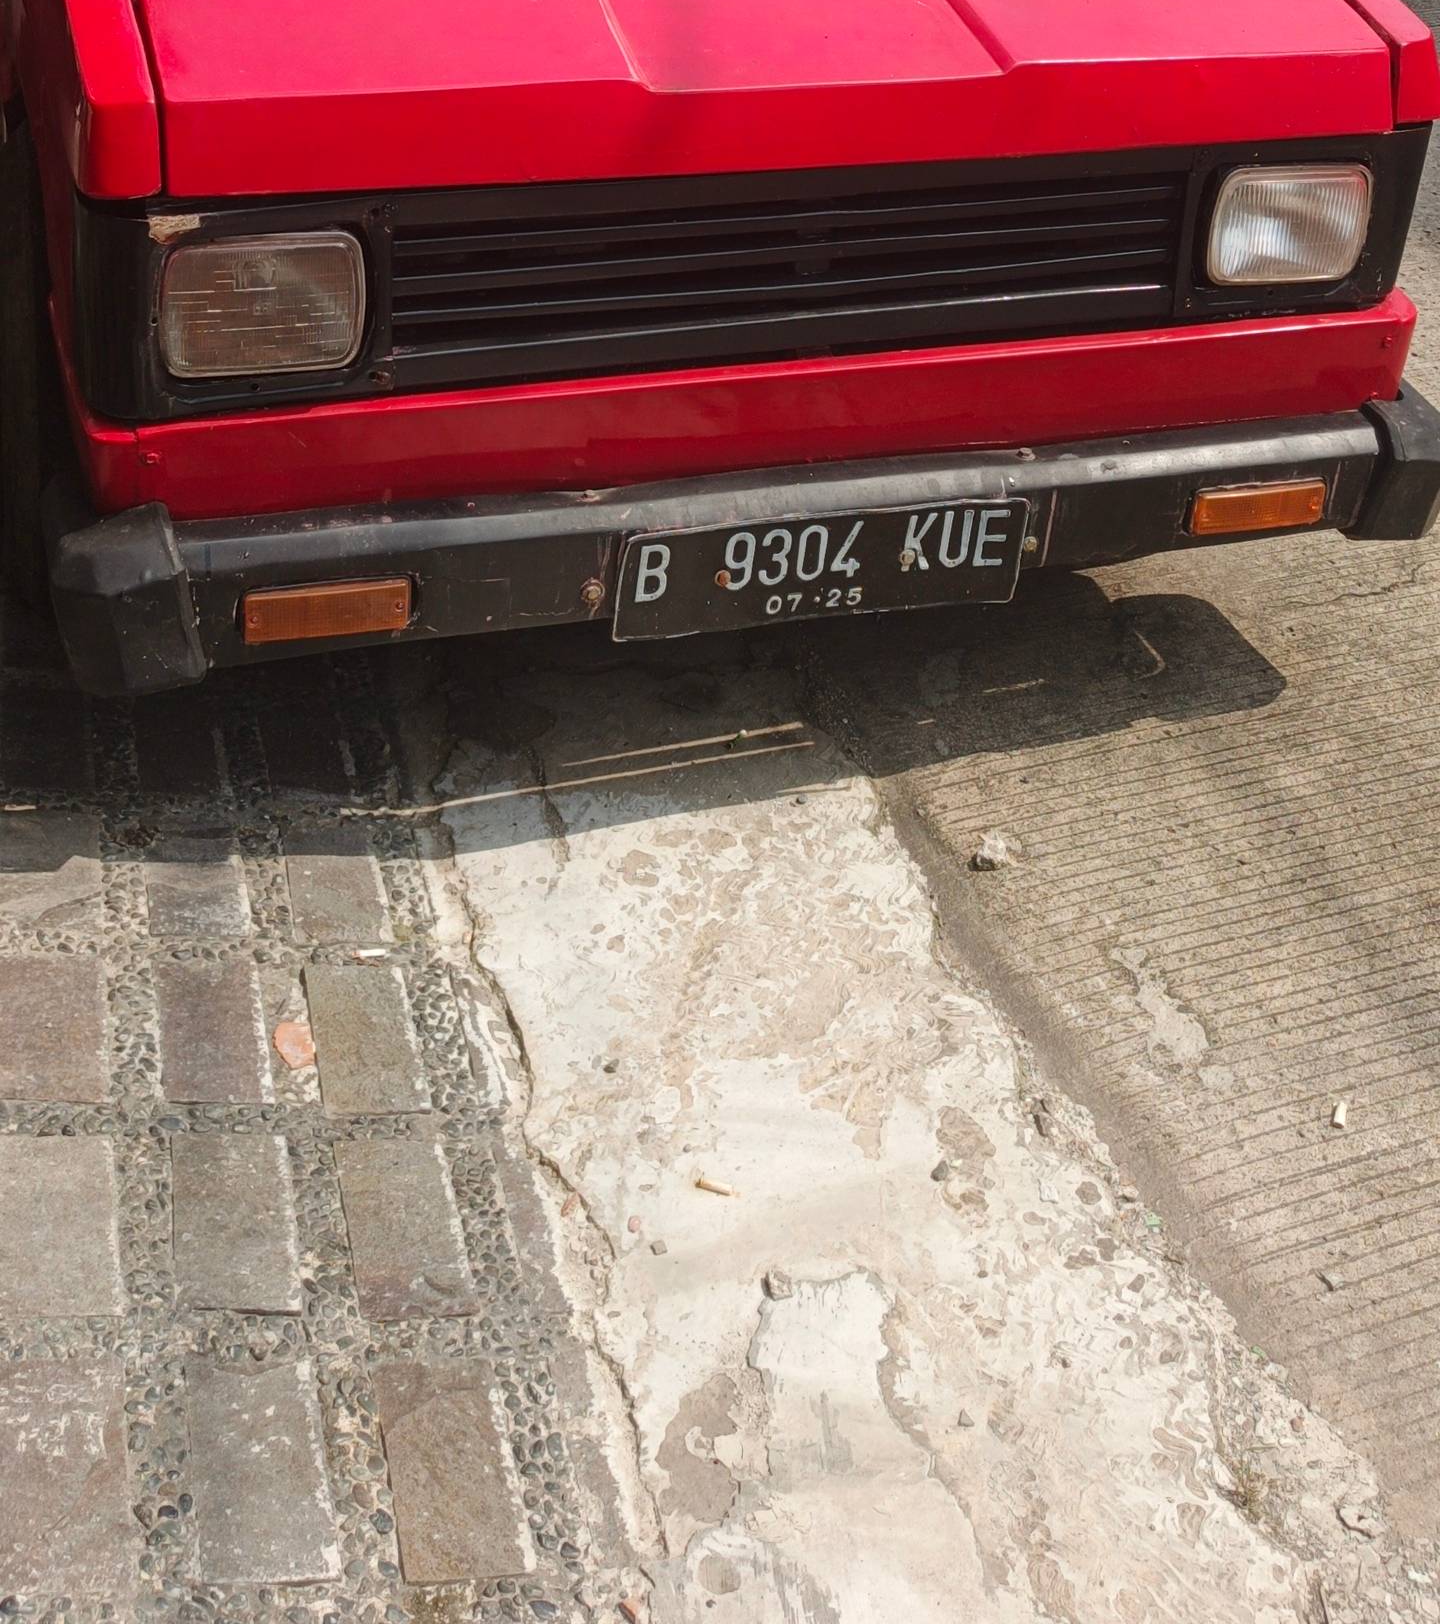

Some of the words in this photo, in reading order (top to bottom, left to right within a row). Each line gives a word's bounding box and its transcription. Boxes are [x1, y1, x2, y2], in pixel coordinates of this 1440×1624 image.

[634, 544, 671, 603] B
[724, 520, 865, 591] 9304
[900, 509, 1012, 573] KUE
